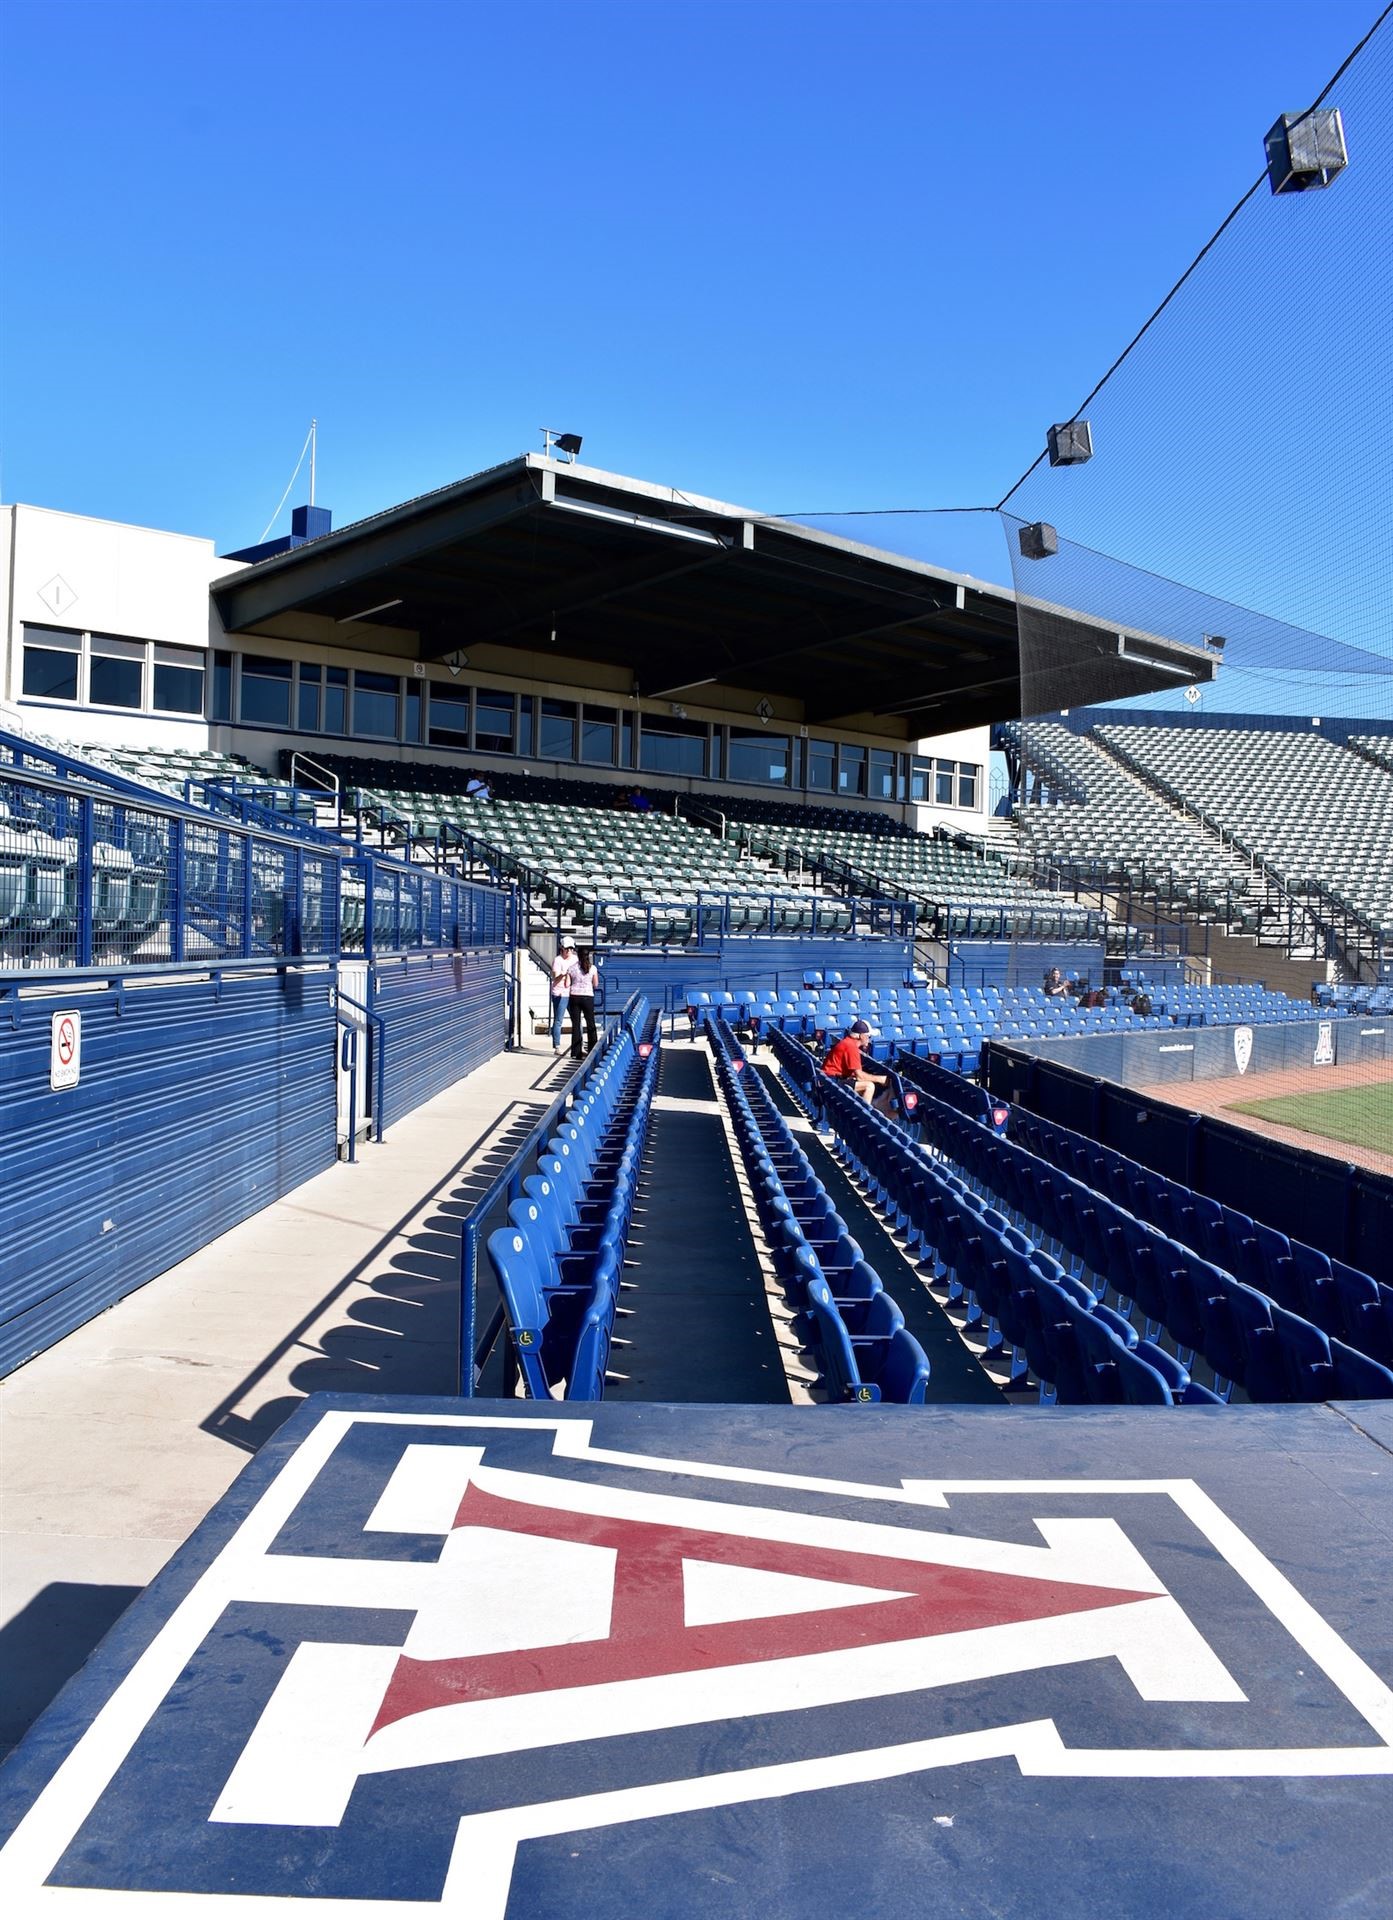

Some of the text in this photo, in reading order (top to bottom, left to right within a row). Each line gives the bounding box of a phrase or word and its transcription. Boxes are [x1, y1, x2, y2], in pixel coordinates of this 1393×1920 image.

[56, 586, 60, 605] I
[450, 651, 460, 667] J
[760, 703, 769, 718] K
[598, 956, 604, 967] J
[1313, 1022, 1334, 1064] A
